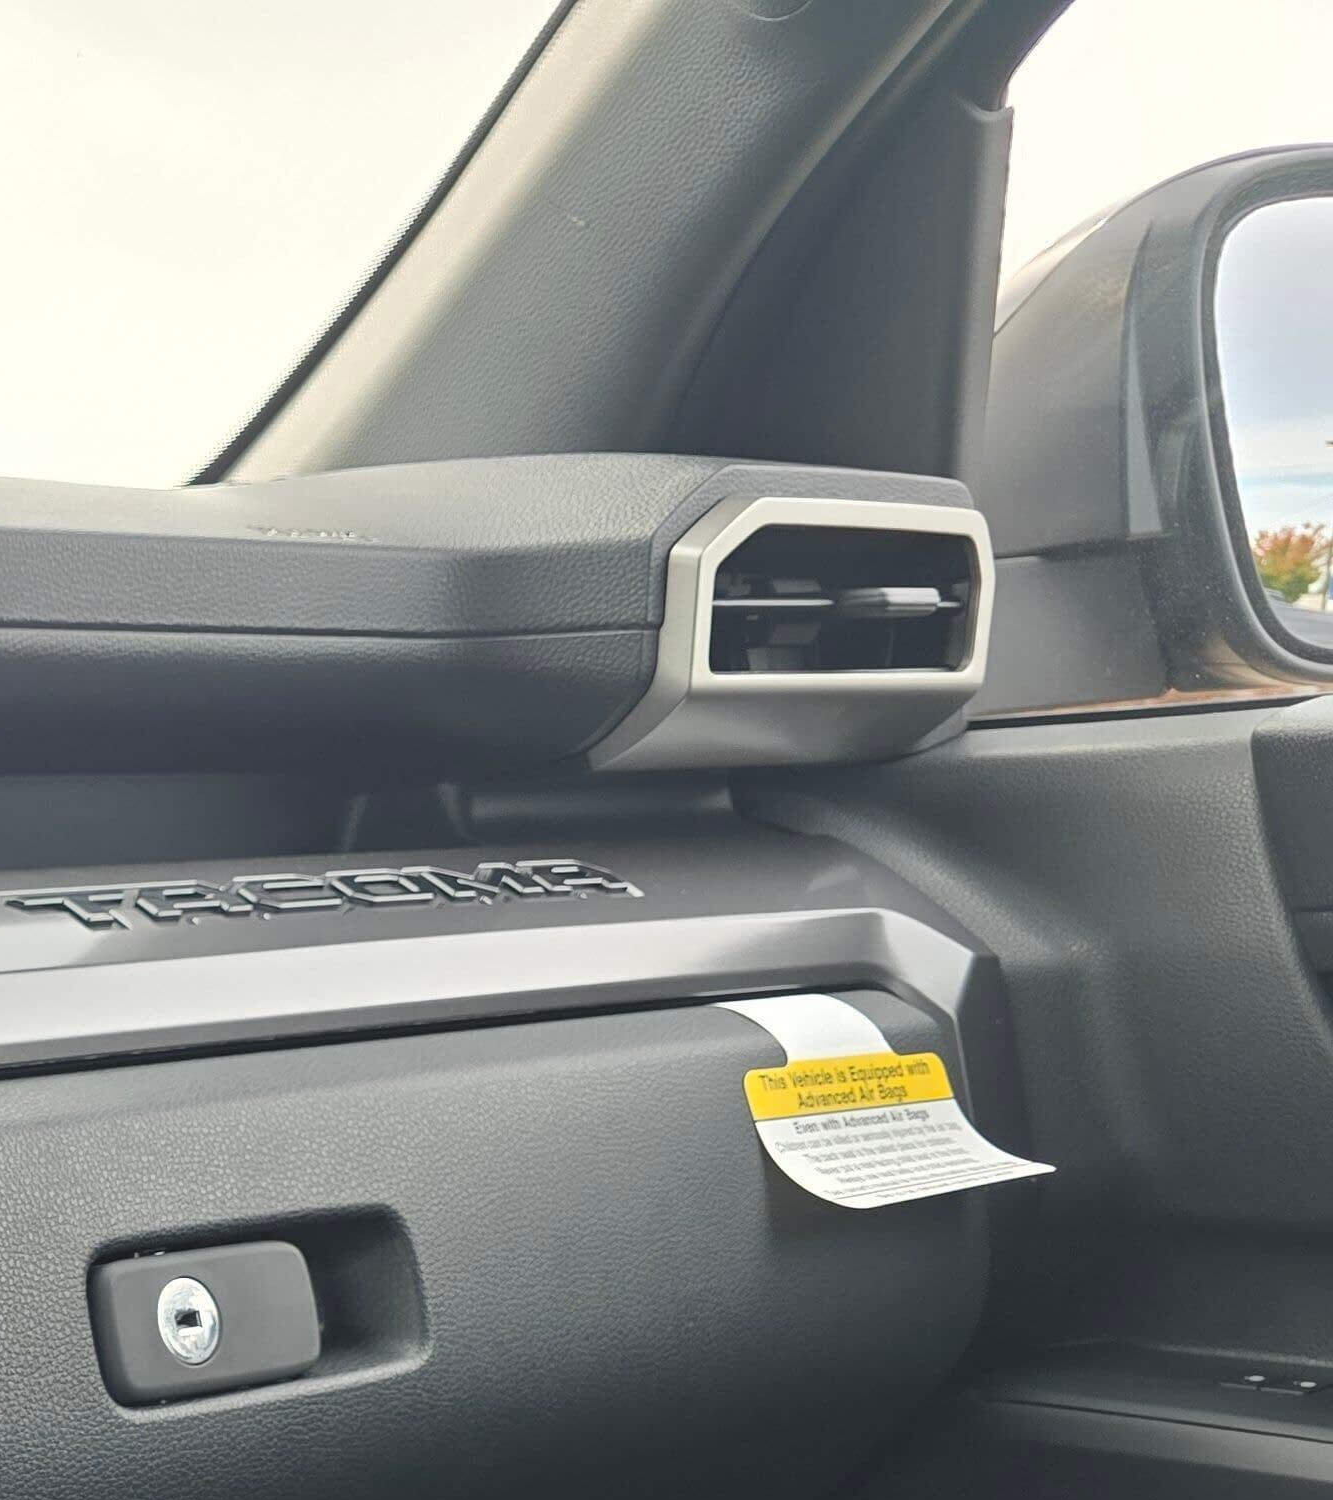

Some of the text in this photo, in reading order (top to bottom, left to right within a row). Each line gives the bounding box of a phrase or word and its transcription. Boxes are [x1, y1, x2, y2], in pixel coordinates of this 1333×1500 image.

[759, 1061, 931, 1092] This Vehicle is Equipped with
[797, 1082, 908, 1109] Advanced Air Bags
